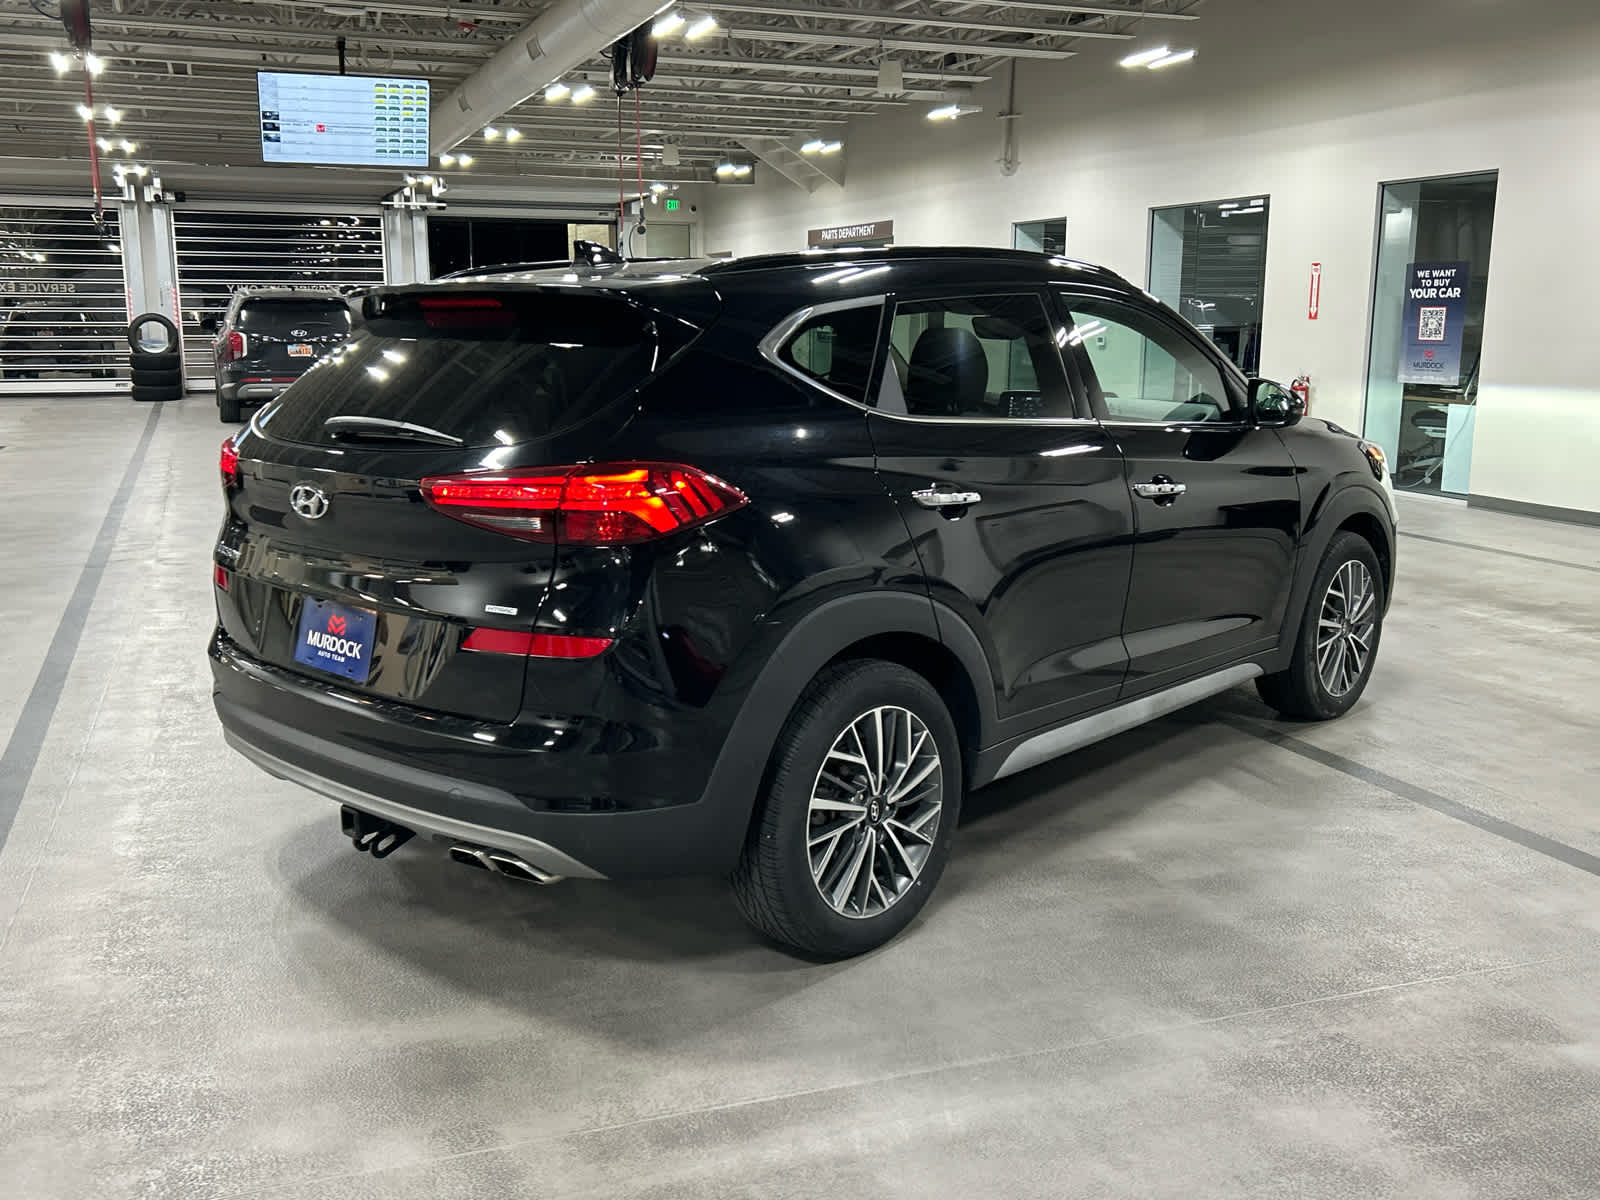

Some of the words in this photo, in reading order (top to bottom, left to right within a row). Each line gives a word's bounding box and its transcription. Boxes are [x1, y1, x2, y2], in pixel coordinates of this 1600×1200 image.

[821, 229, 838, 241] PARTS
[838, 224, 875, 239] DEPARTMENT
[1417, 270, 1430, 278] WE
[1432, 269, 1456, 277] WANT
[1433, 279, 1451, 287] BUY
[1410, 288, 1437, 299] YOUR
[1438, 288, 1461, 298] CAR
[306, 630, 362, 659] MURDOCK
[317, 650, 331, 658] AUTO
